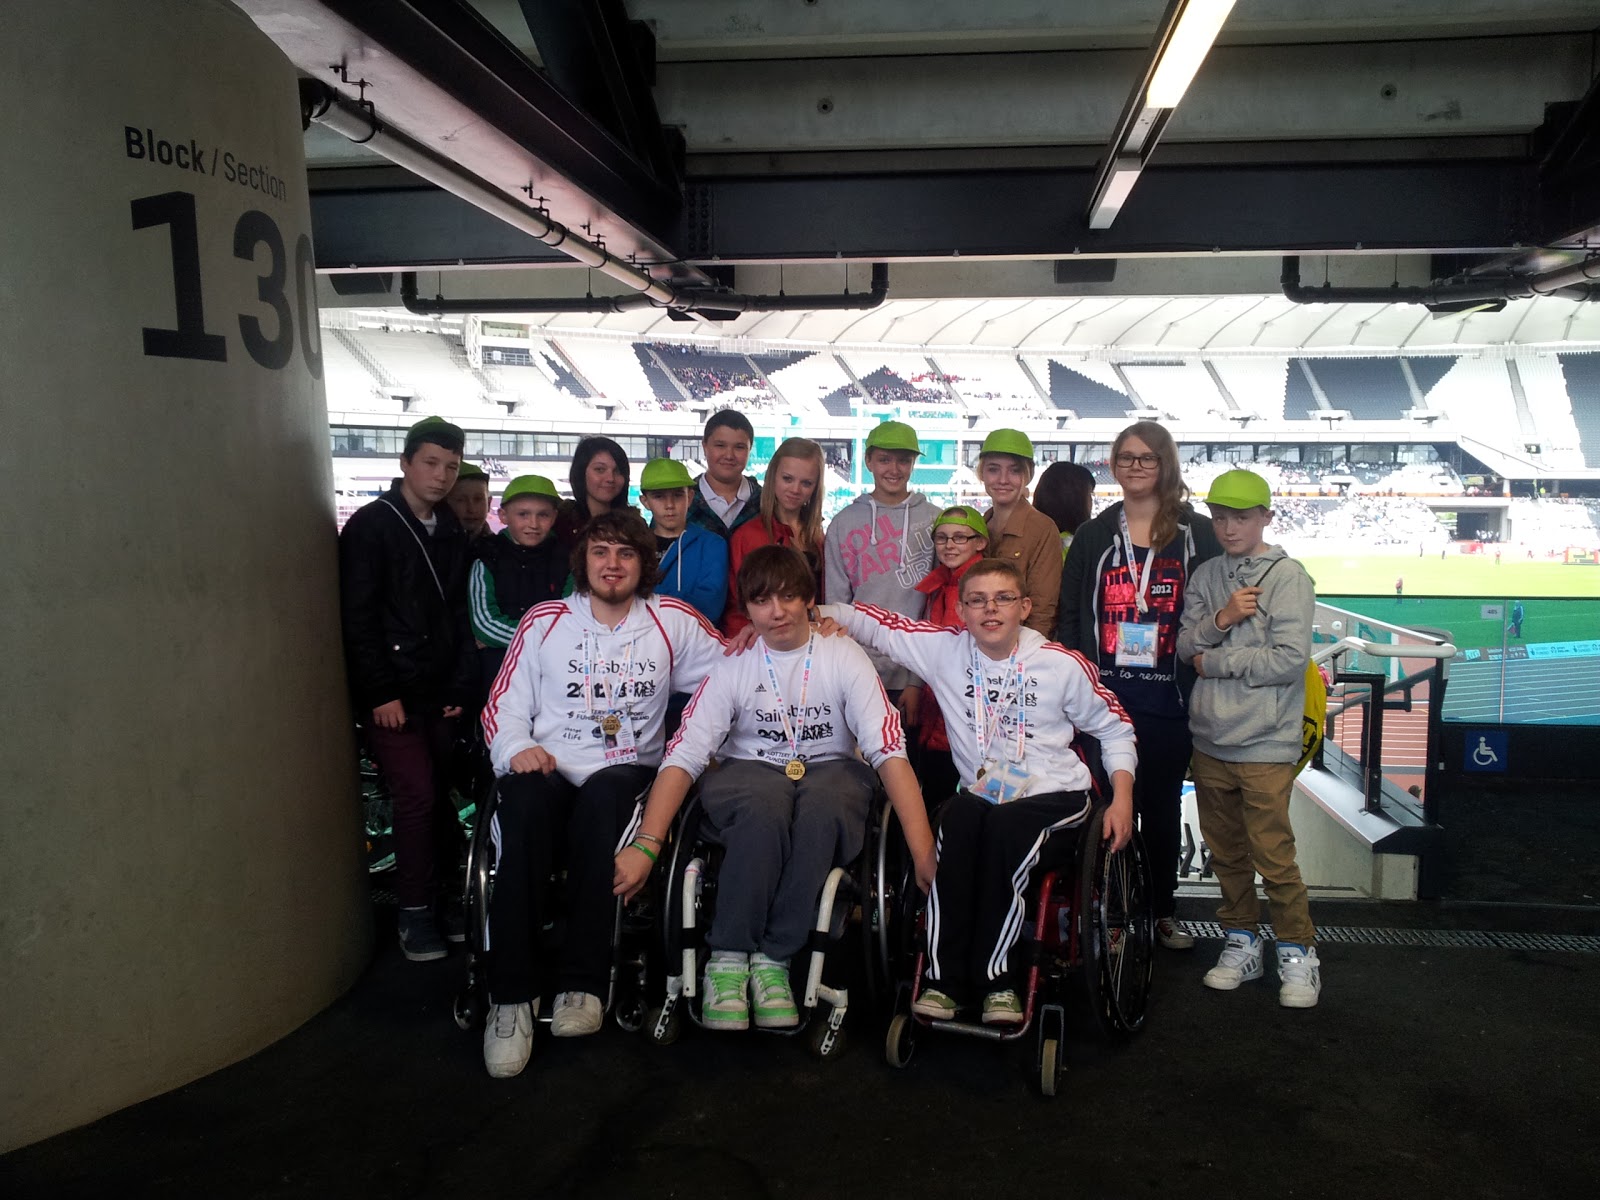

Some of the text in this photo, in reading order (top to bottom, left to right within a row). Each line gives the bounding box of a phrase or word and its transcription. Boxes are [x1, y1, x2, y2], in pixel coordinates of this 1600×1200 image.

[124, 126, 206, 174] Block
[223, 152, 287, 201] Section
[130, 190, 323, 380] 130
[1151, 584, 1172, 595] 2012
[568, 658, 656, 676] Sainsby's
[1120, 668, 1134, 679] to
